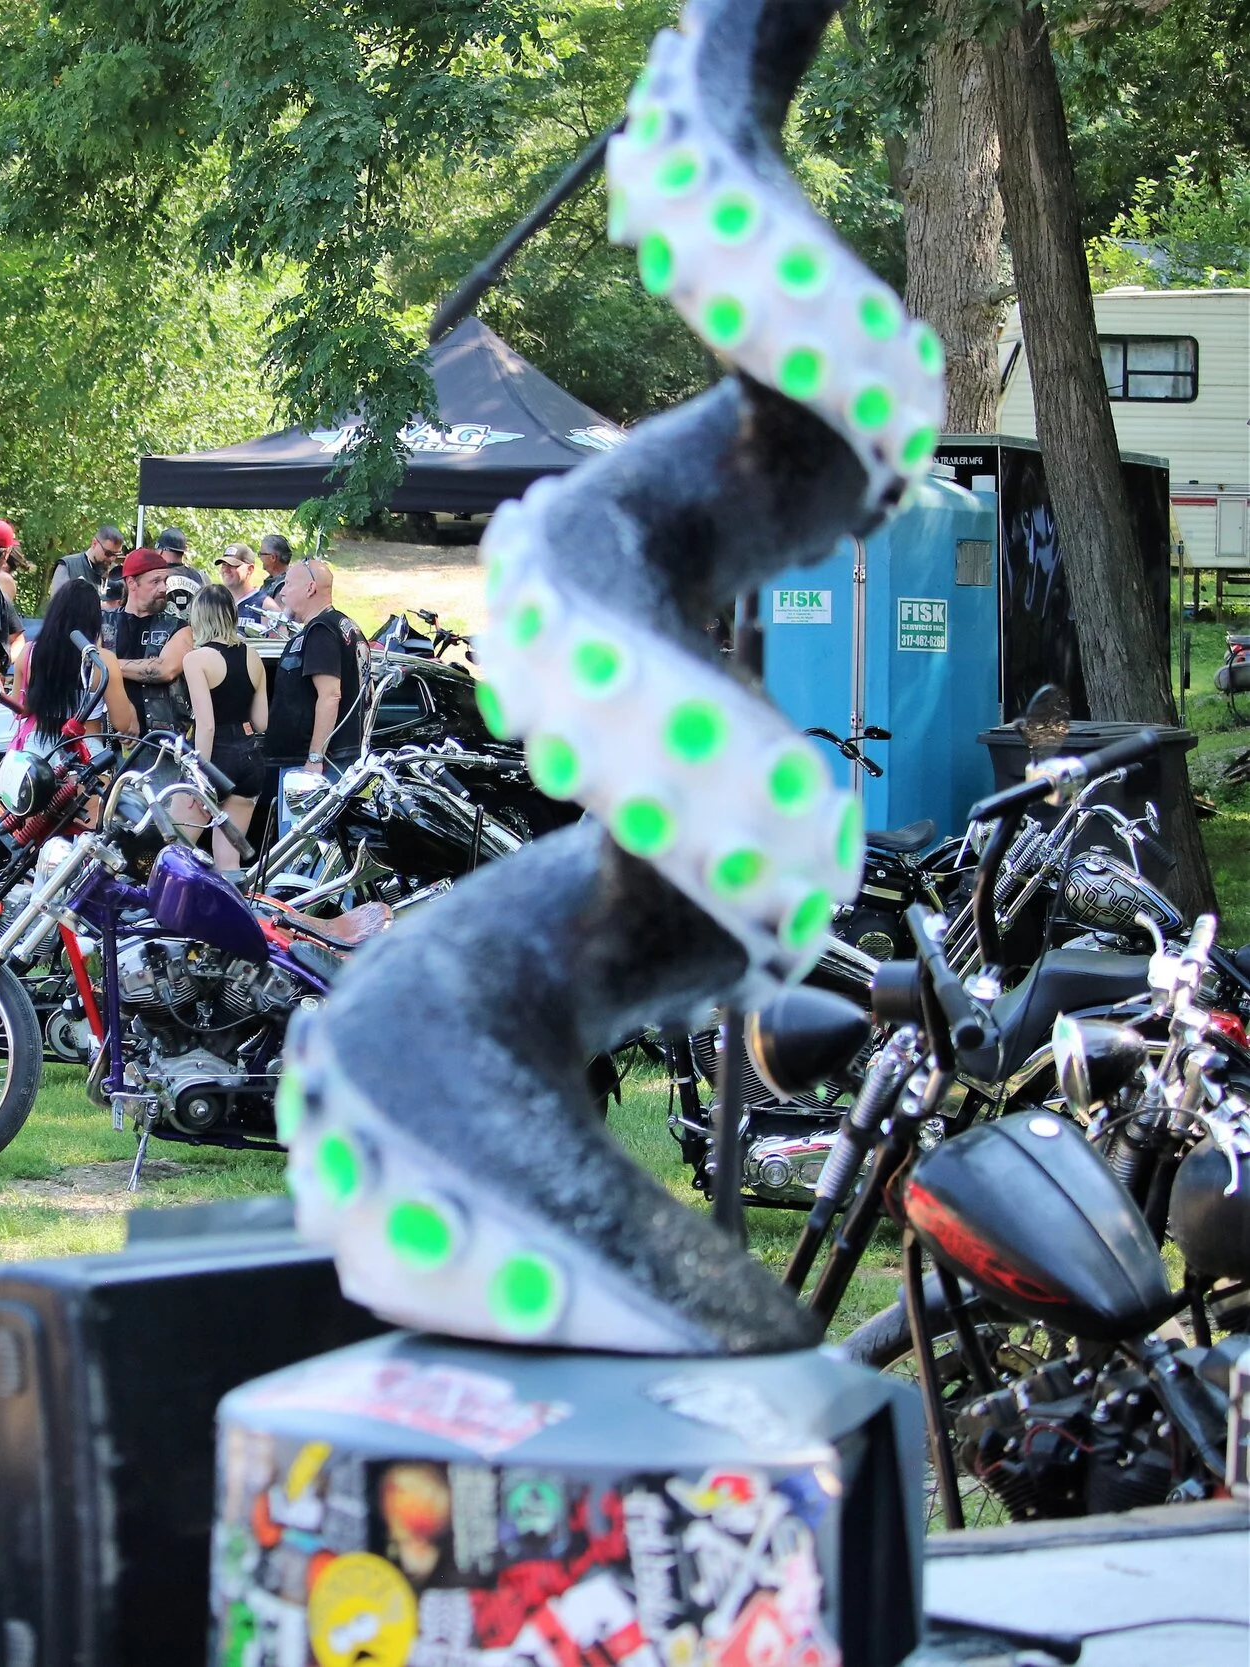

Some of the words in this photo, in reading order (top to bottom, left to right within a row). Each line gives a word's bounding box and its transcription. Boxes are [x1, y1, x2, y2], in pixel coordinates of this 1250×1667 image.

[940, 456, 968, 465] TRAILER
[969, 456, 983, 465] MFG
[779, 591, 822, 608] FISK
[901, 602, 945, 622] FISK
[901, 623, 932, 631] SERVICES
